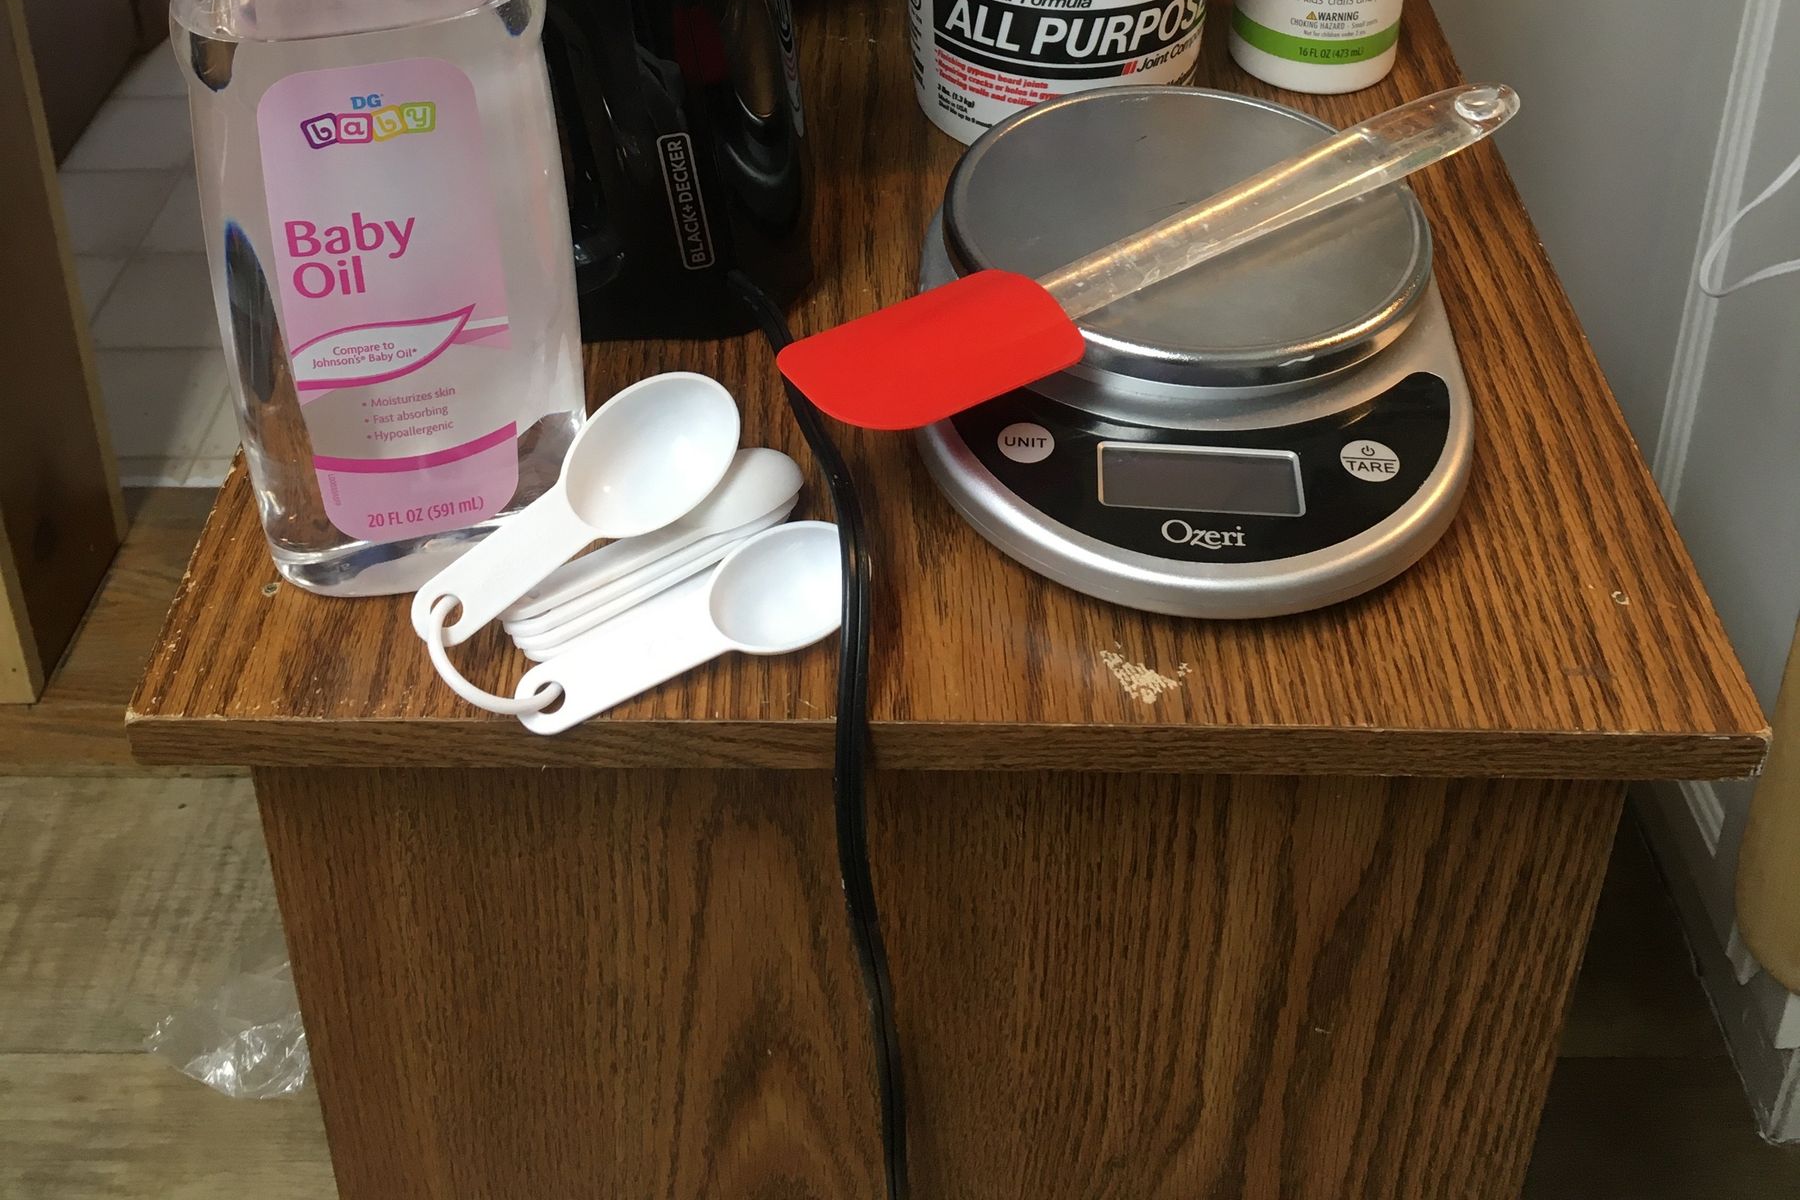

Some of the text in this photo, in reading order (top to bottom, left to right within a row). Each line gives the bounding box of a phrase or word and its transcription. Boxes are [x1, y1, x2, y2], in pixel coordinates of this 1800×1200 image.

[1318, 11, 1359, 21] WARNING
[1136, 50, 1170, 73] Joint
[1299, 46, 1308, 57] 16
[1310, 47, 1318, 58] FL
[1320, 48, 1331, 59] OZ
[1023, 79, 1049, 89] joints
[350, 94, 382, 110] DG
[308, 105, 431, 144] baby
[667, 140, 706, 263] BLACK+DECKER
[284, 212, 415, 259] Baby
[293, 255, 366, 298] Oil
[332, 341, 395, 357] Compare to
[368, 352, 394, 365] Baby
[371, 385, 456, 408] Moisturizes skin
[373, 404, 449, 425] Fast absorbing
[374, 420, 454, 442] Hypoallergenic
[1004, 436, 1047, 450] UNIT
[1346, 458, 1396, 475] TARE
[368, 495, 484, 528] 20 FL OZ (591 mL)
[1161, 519, 1247, 550] Ozeri
